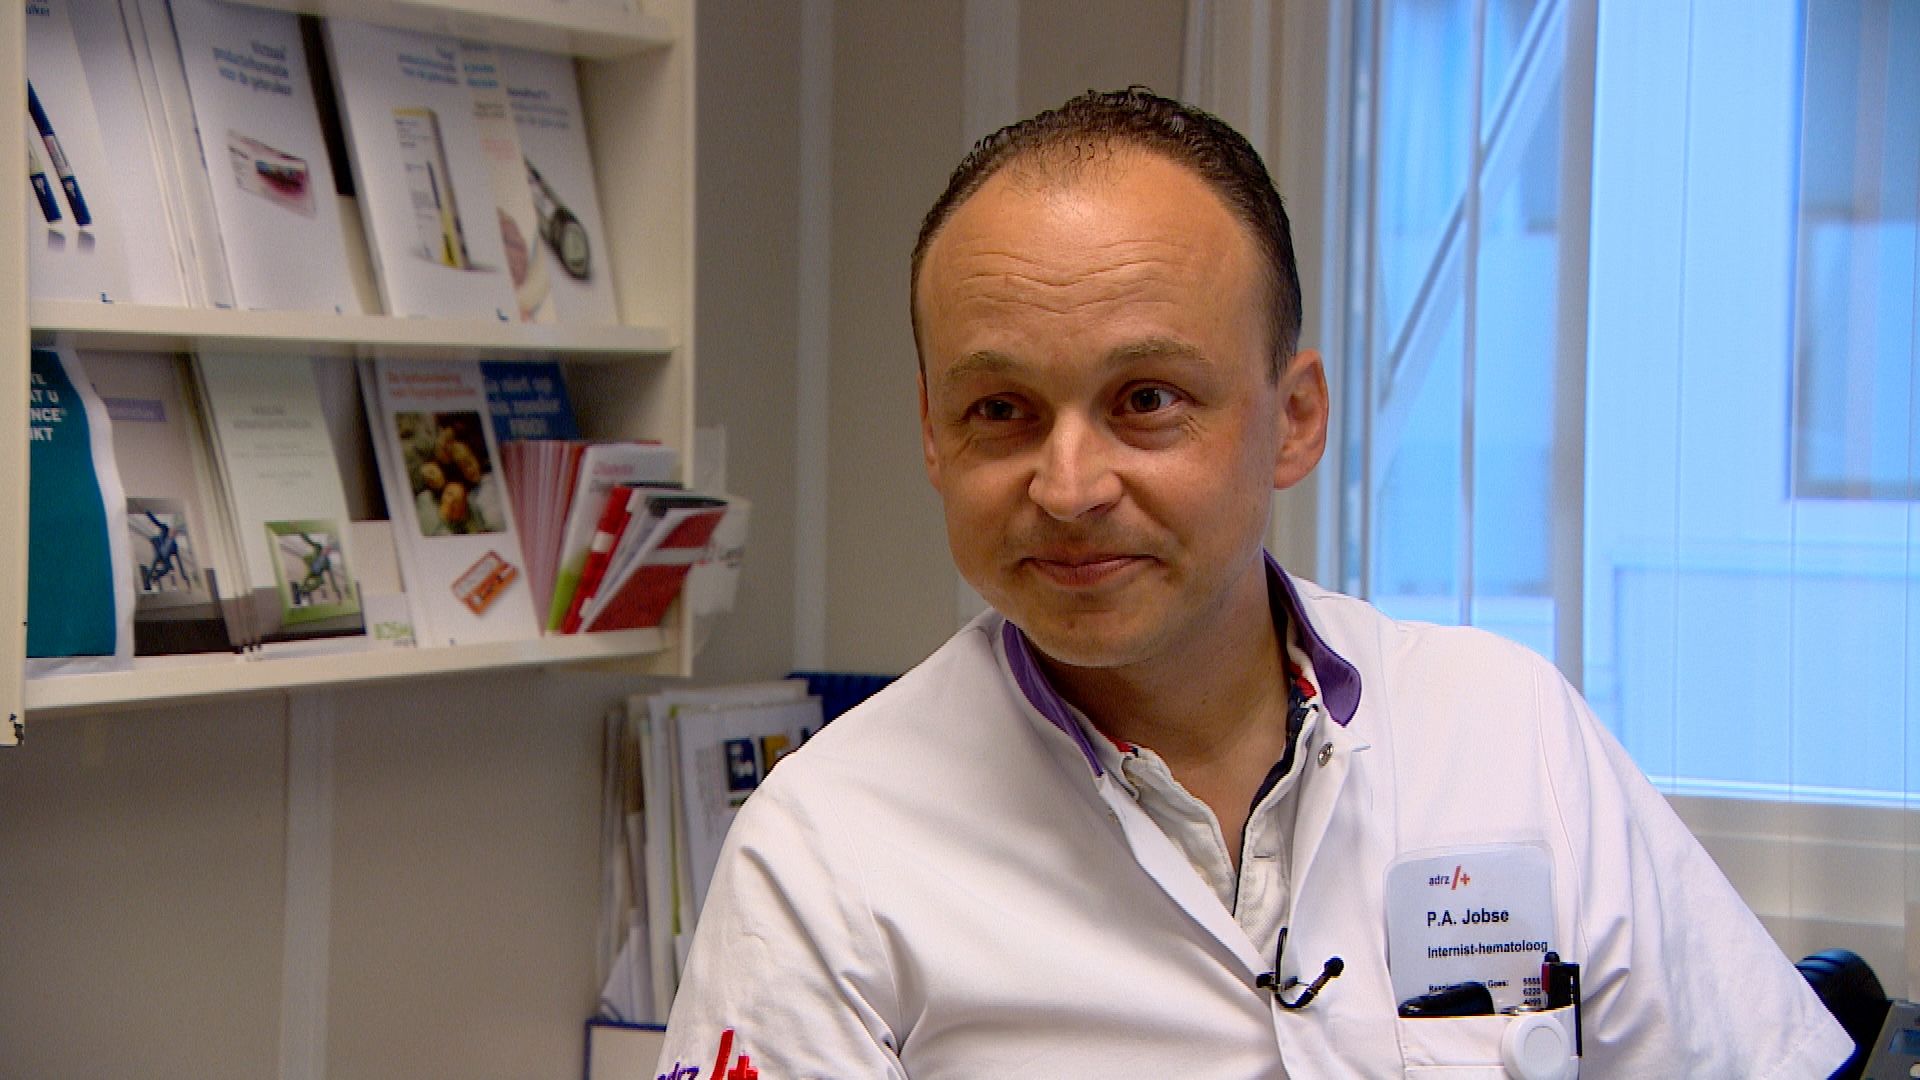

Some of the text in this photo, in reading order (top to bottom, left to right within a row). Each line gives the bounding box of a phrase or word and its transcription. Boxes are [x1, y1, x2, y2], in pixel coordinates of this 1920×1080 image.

[1427, 908, 1509, 927] P.A. Jobse
[1427, 940, 1548, 959] Internist-hematoloog
